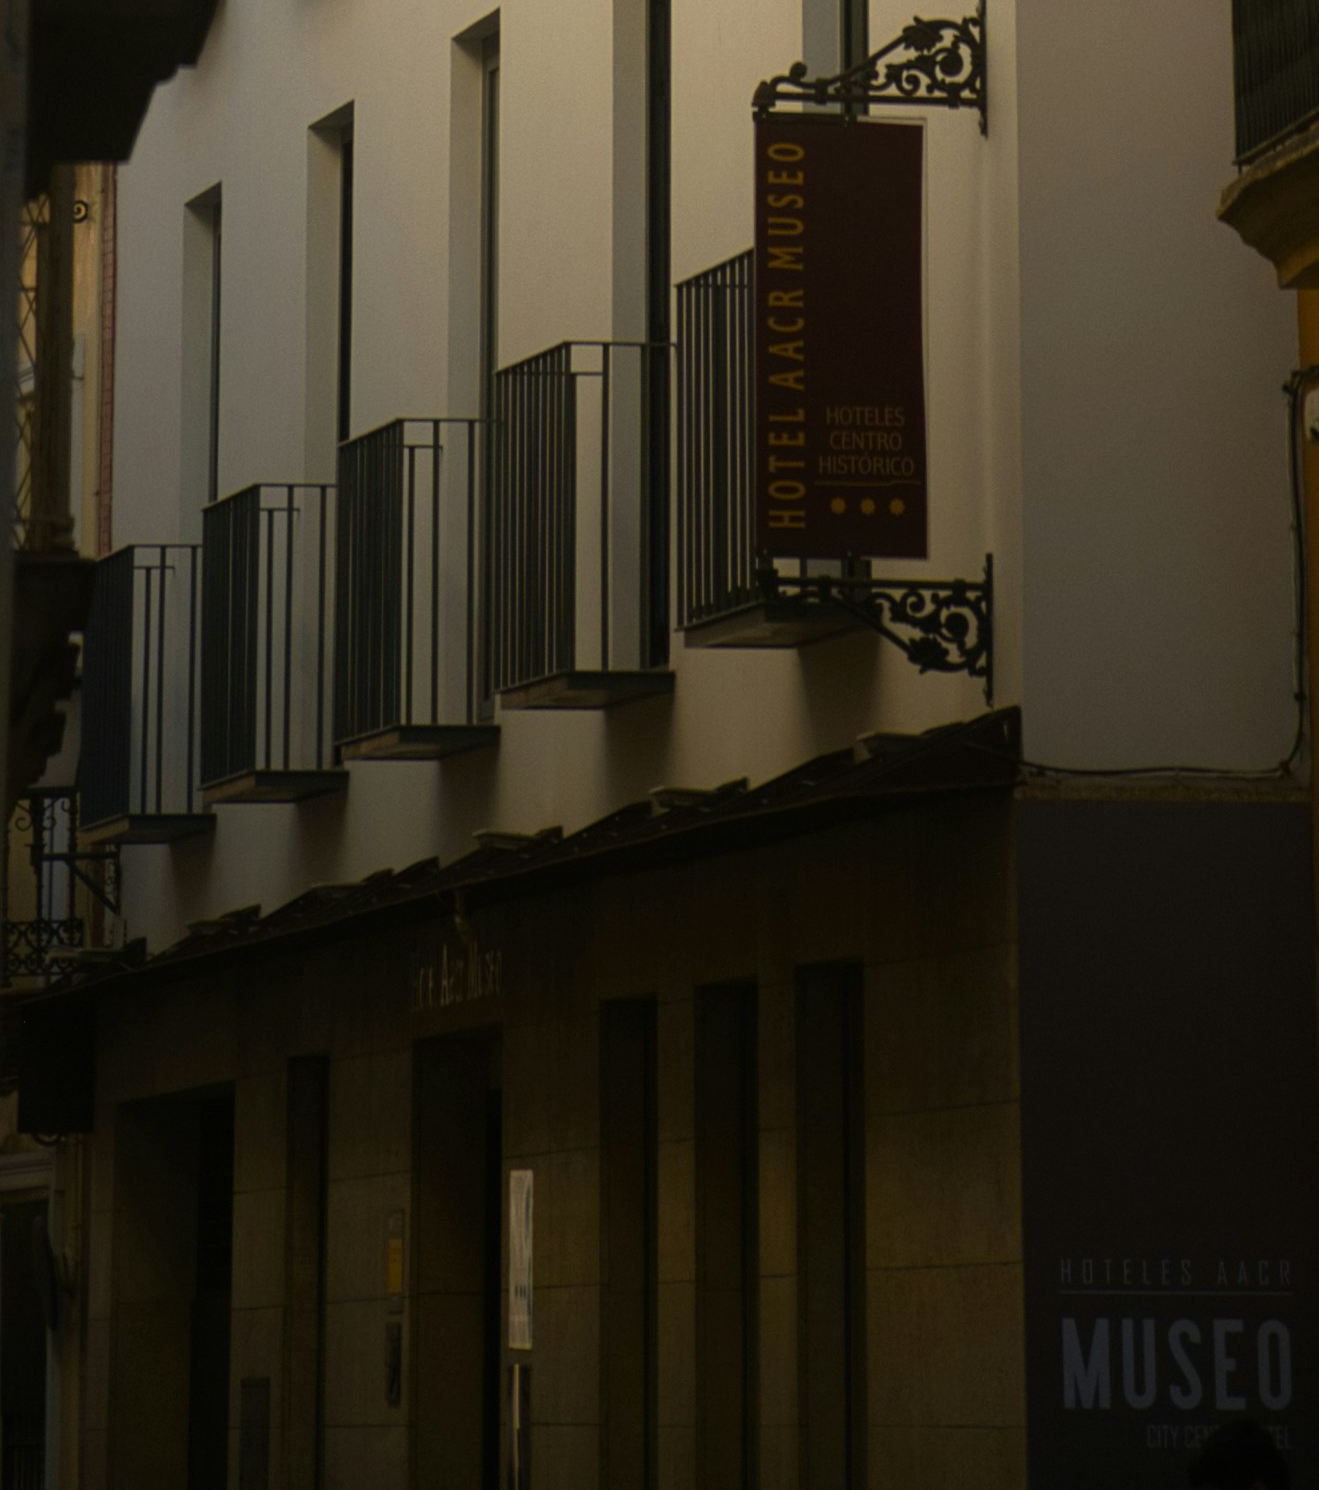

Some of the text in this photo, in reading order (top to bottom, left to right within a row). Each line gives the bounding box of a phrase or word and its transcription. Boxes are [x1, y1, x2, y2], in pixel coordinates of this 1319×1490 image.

[766, 140, 807, 530] HOTEL AACR MUSEO
[825, 405, 905, 427] HOTELES
[829, 429, 903, 452] CENTRO
[818, 451, 915, 477] HISTÓRICO
[1059, 1258, 1292, 1286] HOTELES AACR
[1060, 1317, 1293, 1411] MUSEO
[1146, 1424, 1179, 1449] CITY
